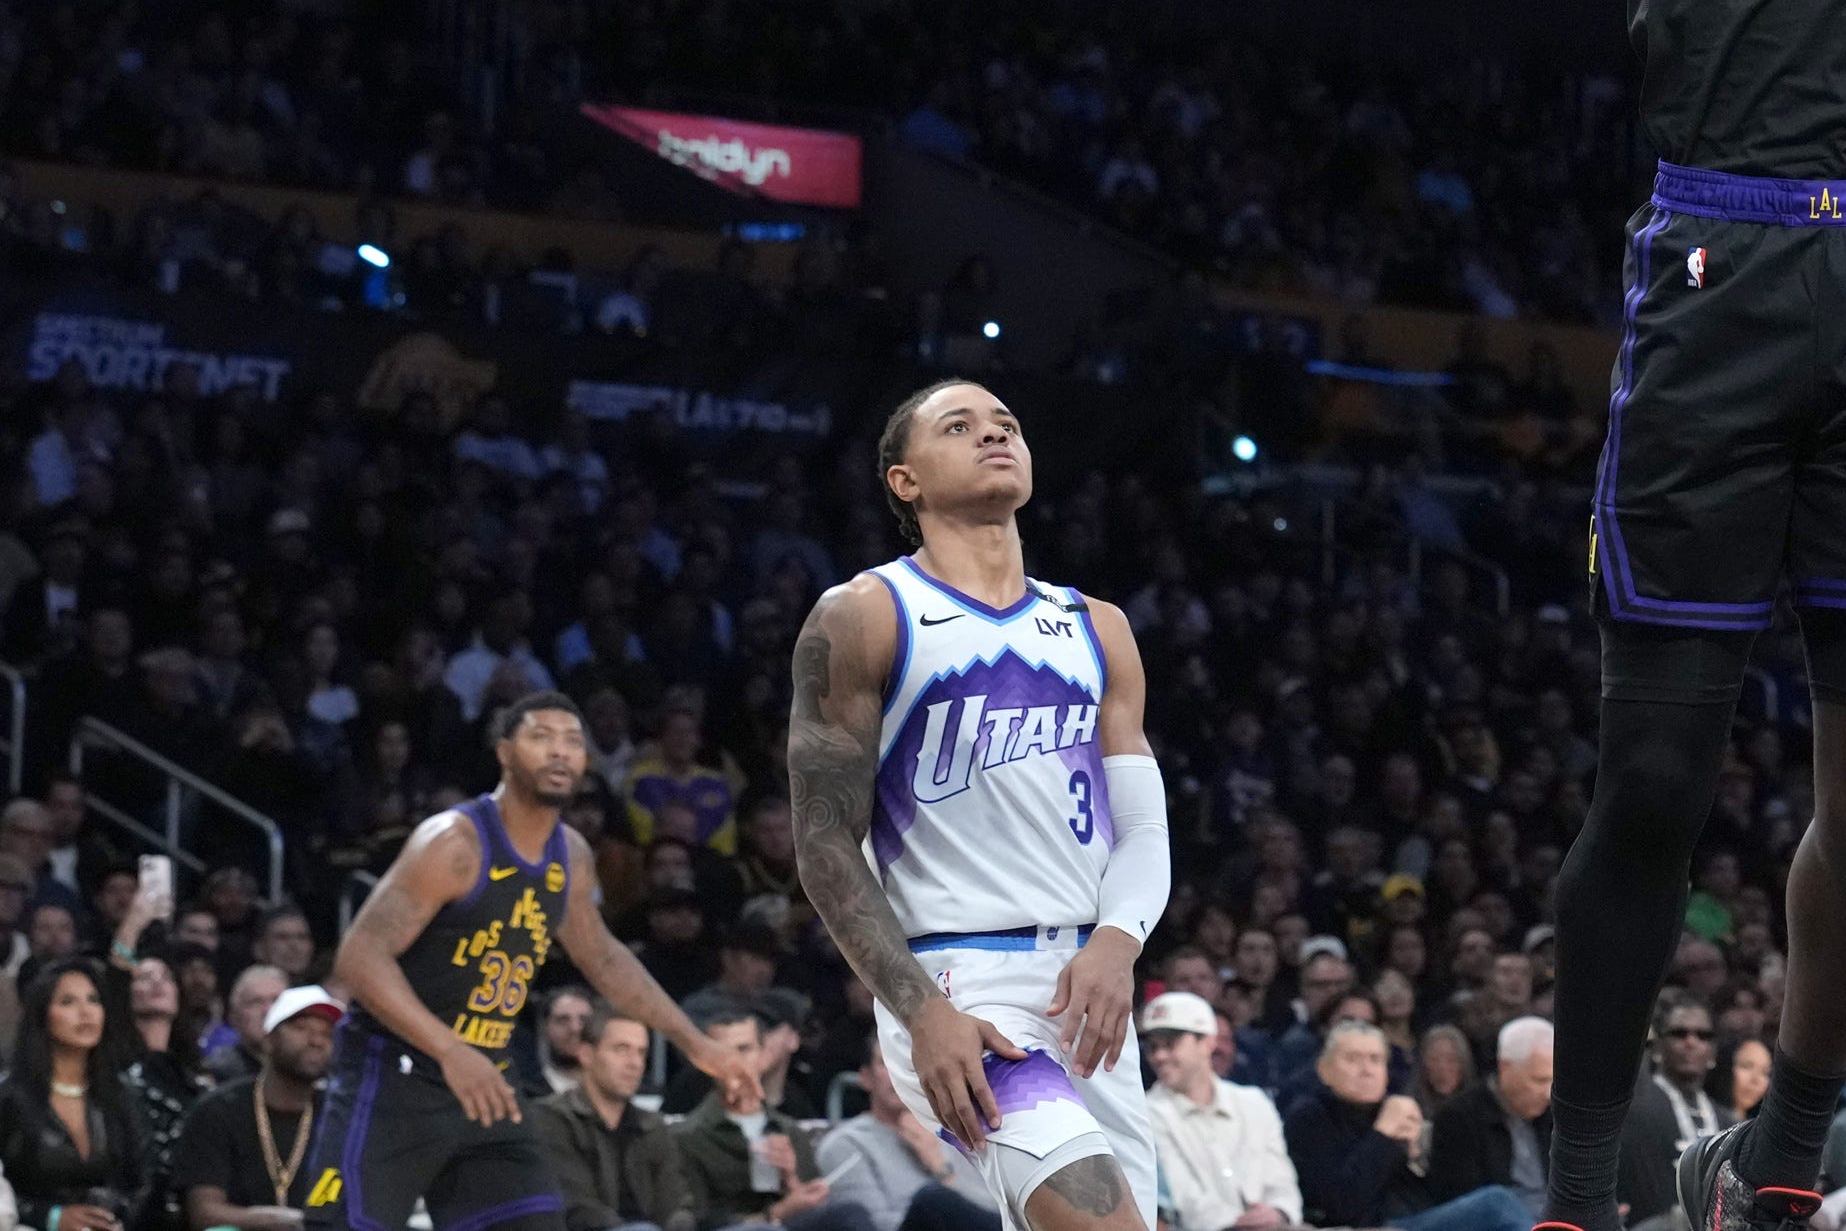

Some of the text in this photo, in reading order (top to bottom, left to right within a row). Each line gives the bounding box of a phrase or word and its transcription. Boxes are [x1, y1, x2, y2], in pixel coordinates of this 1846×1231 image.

[1810, 187, 1842, 219] LAL
[1034, 617, 1073, 638] LVT
[912, 694, 1098, 803] UTAH
[1068, 770, 1093, 845] 3
[452, 920, 504, 967] LOS
[467, 950, 534, 1016] 36
